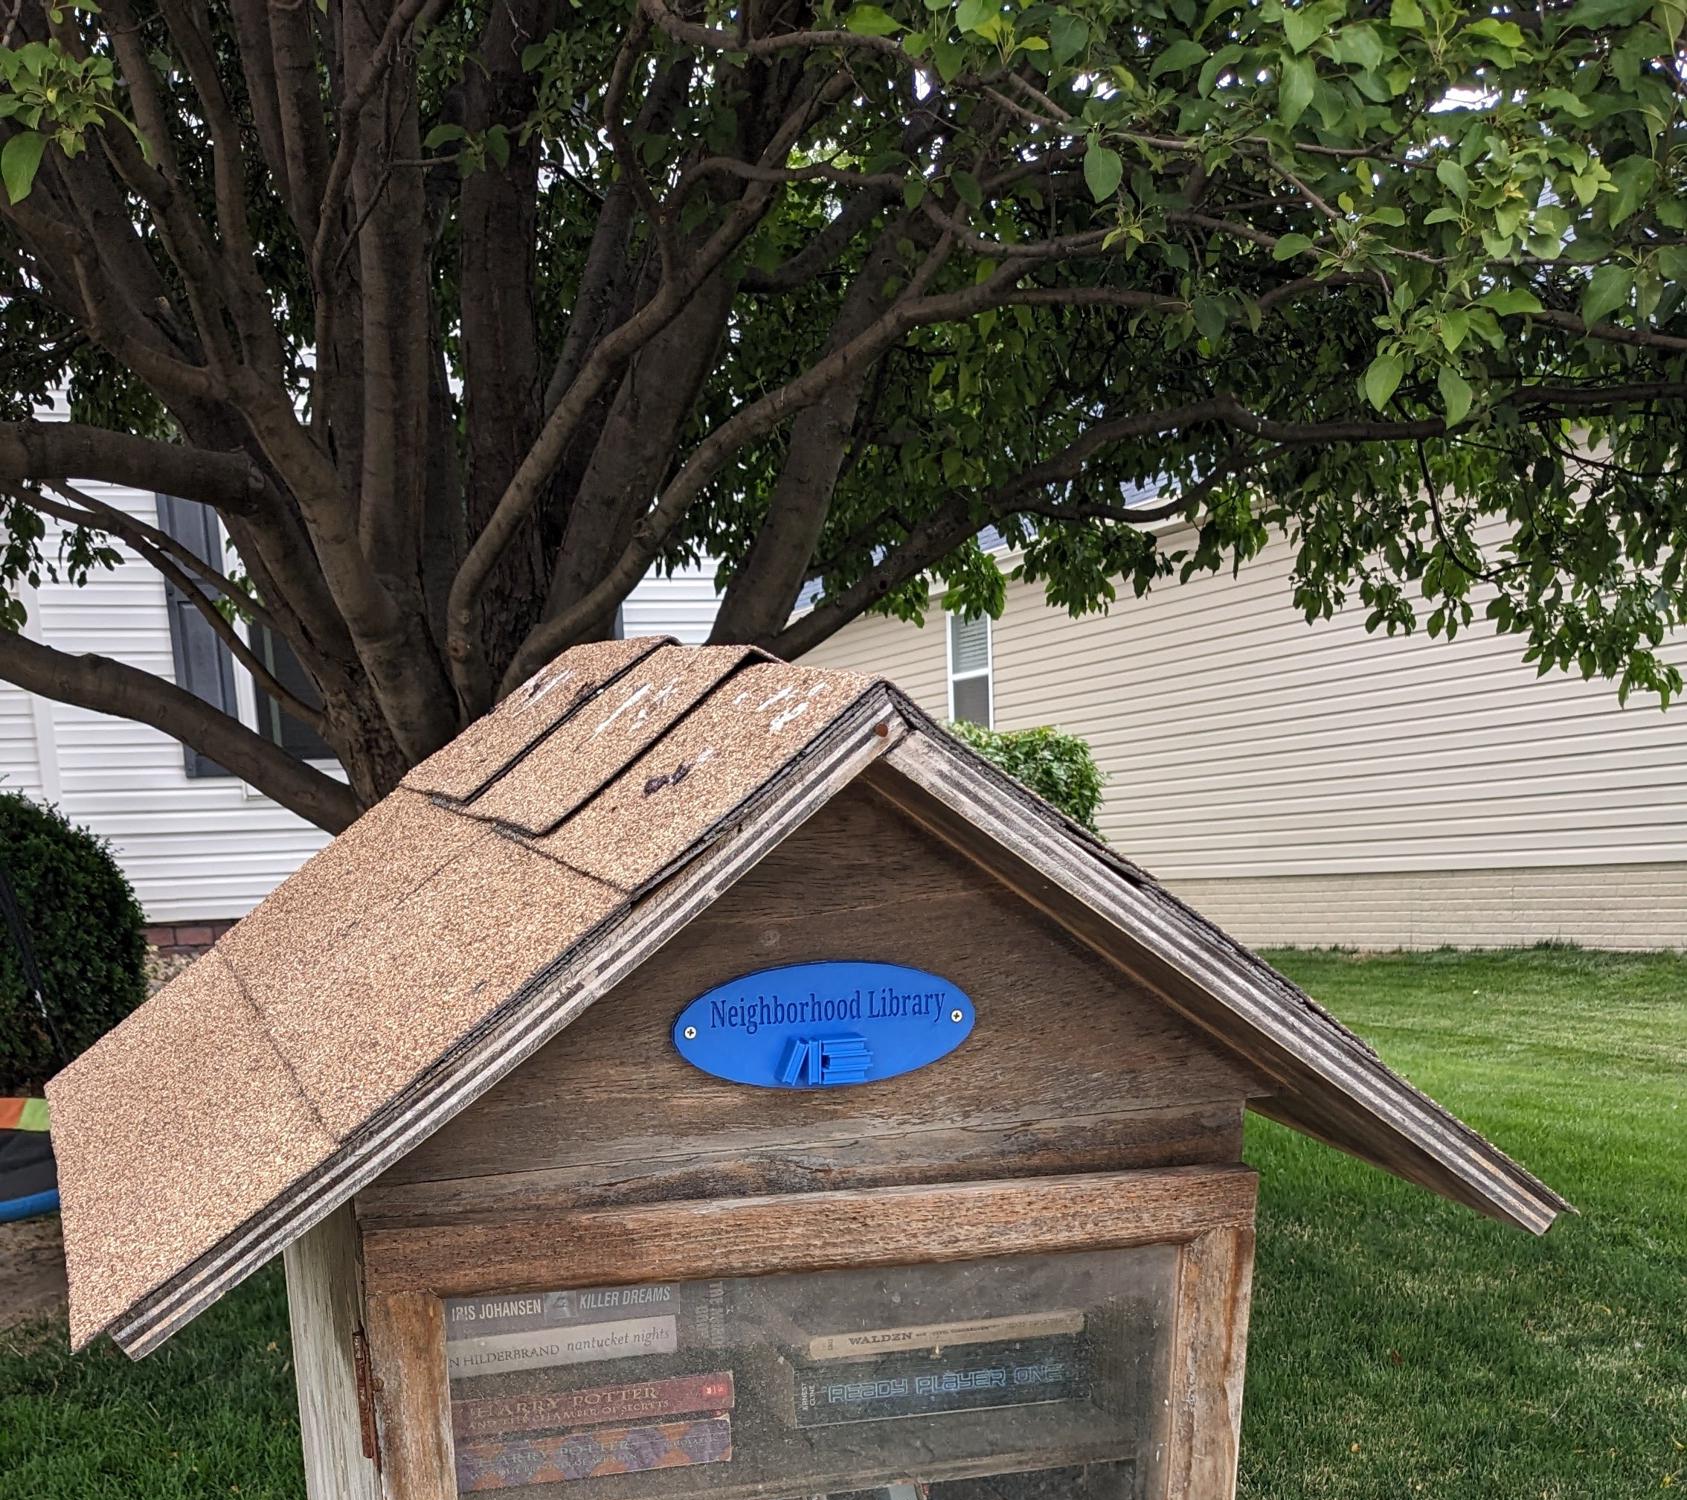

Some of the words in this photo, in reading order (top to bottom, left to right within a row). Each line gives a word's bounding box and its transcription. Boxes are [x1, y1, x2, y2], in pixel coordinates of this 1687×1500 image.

[710, 990, 862, 1034] Neighborhood
[867, 988, 947, 1023] Library
[451, 1305, 476, 1322] IRIS
[479, 1298, 541, 1319] JOHANSEN
[578, 1291, 618, 1310] KILLER
[621, 1286, 671, 1305] DREAMS
[462, 1343, 560, 1368] HILDERBRAND
[565, 1330, 629, 1354] nantucket
[632, 1323, 671, 1348] nights
[848, 1332, 912, 1346] WALDEN
[469, 1397, 562, 1422] HARRY
[573, 1386, 658, 1410] POTTER
